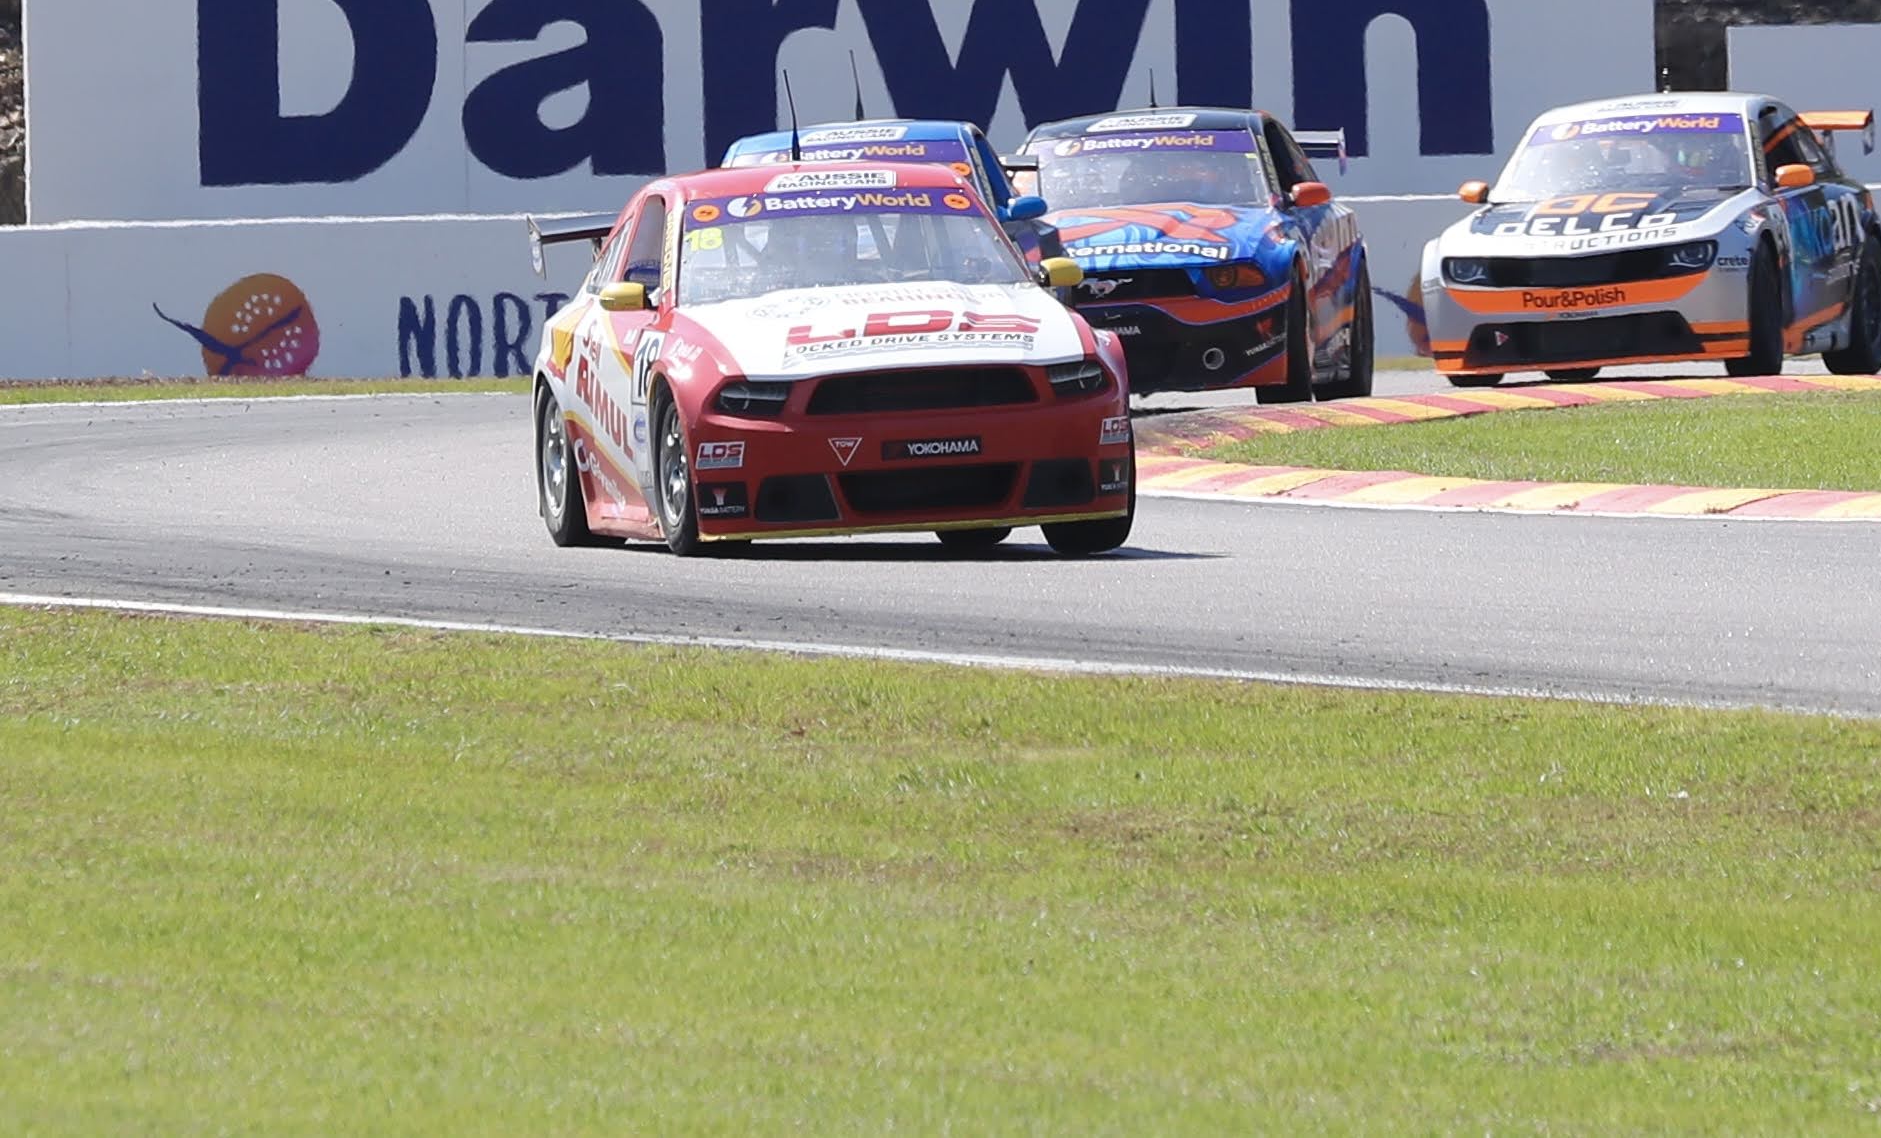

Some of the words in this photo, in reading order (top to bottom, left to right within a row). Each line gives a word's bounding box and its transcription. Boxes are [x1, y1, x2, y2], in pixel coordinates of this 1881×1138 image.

[1580, 117, 1721, 135] BatteryWorld
[1082, 135, 1216, 152] BatteryWorld
[776, 179, 838, 190] RACING
[799, 171, 886, 182] AUSSIE
[764, 192, 931, 212] BatteryWorld
[684, 226, 724, 252] 18
[1066, 241, 1229, 261] ternational
[1521, 287, 1627, 309] Pour&Polish
[785, 309, 1042, 347] LDS
[783, 338, 864, 359] LOCKED
[870, 334, 930, 346] DRIVE
[937, 332, 1036, 344] SYSTEMS
[700, 444, 742, 459] LDS
[834, 440, 854, 448] TOW
[907, 439, 979, 455] YOKOHAMA
